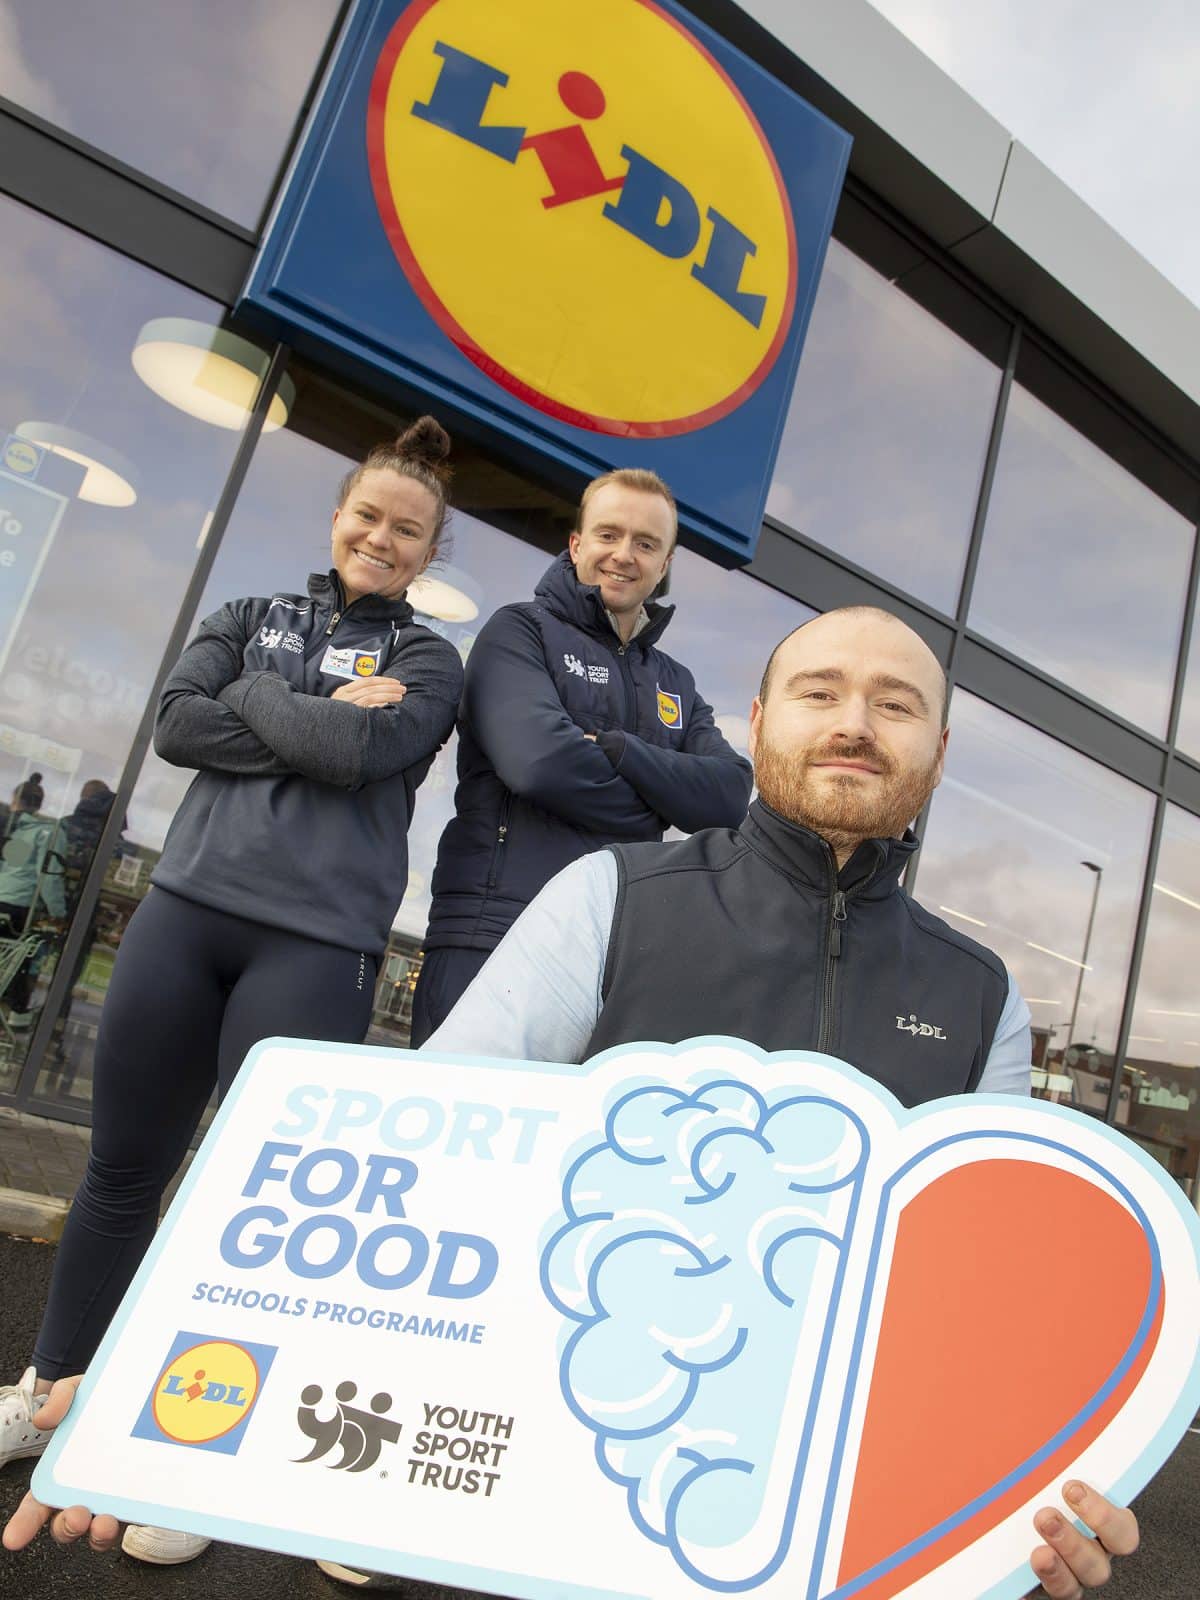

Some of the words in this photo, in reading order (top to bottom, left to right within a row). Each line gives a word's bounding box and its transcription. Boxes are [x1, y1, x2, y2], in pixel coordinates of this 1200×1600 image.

[280, 642, 305, 655] TRUST
[587, 665, 609, 673] YOUTH
[588, 671, 609, 679] SPORT
[271, 1084, 560, 1165] SPORT
[241, 1140, 419, 1219] FOR
[219, 1204, 500, 1300] GOOD
[191, 1282, 309, 1317] SCHOOLS
[311, 1299, 487, 1345] PROGRAMME
[423, 1402, 515, 1439] YOUTH
[411, 1431, 508, 1467] SPORT
[407, 1458, 501, 1497] TRUST
